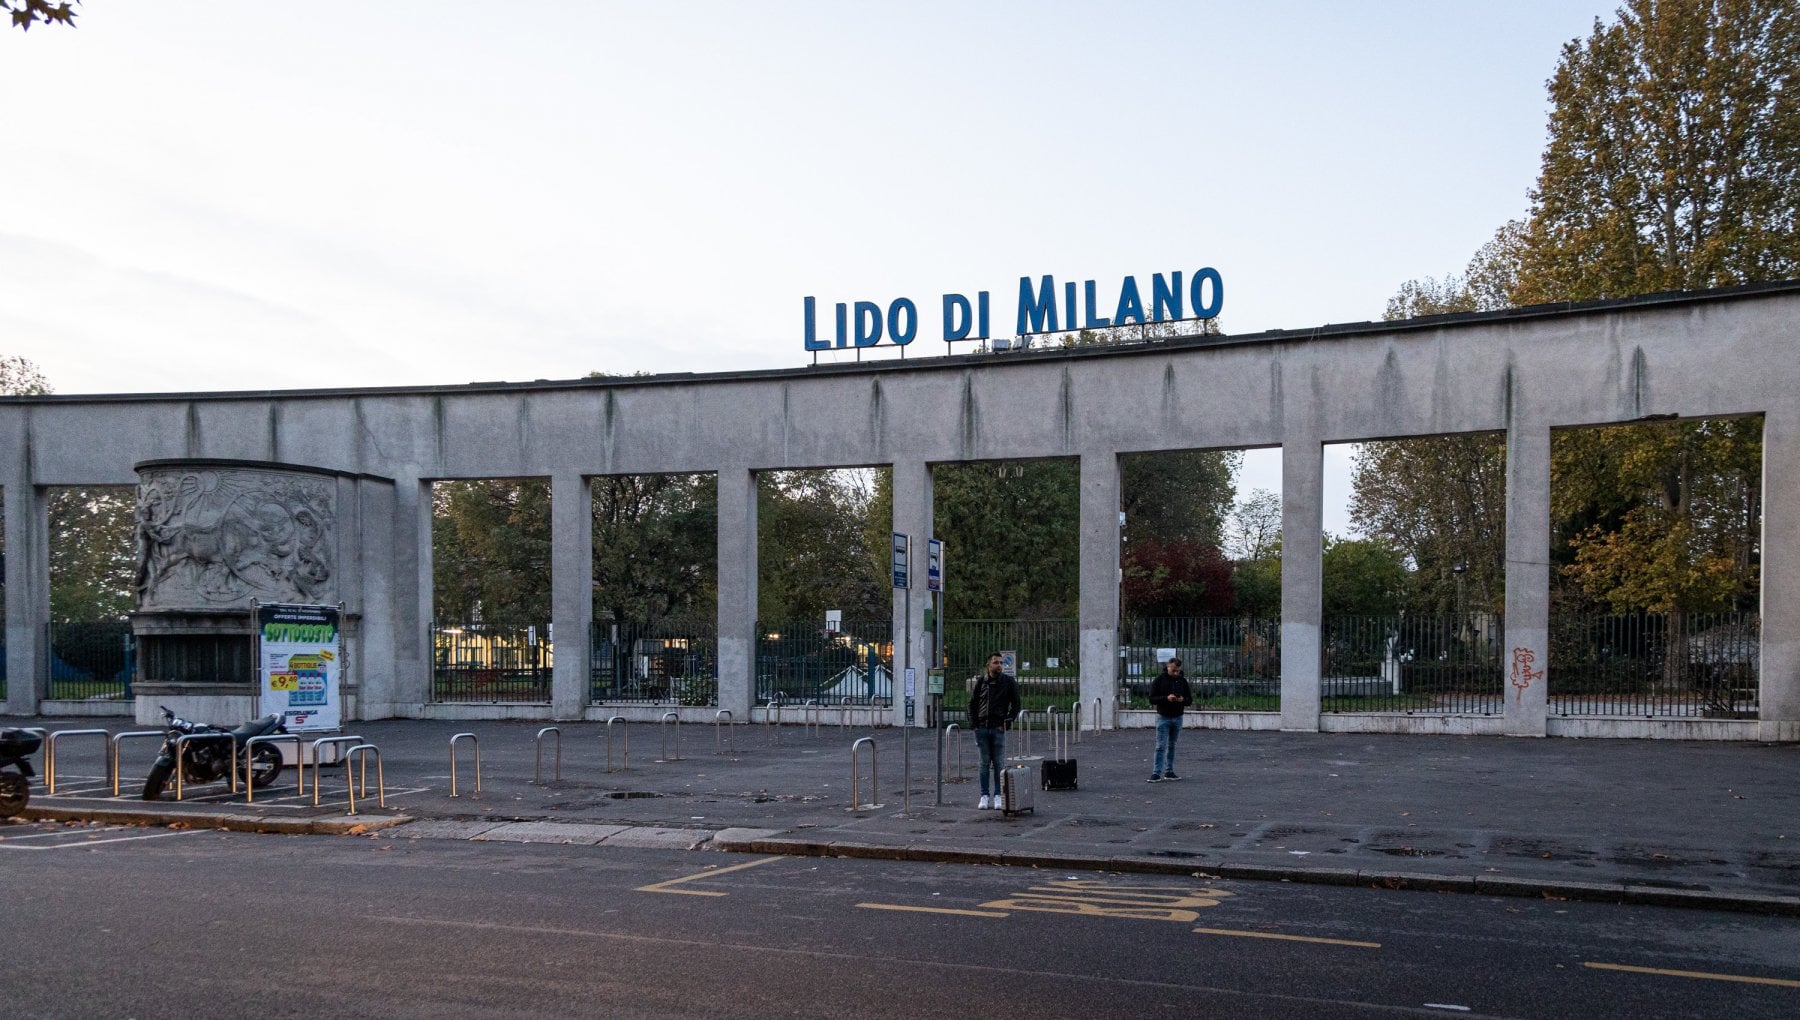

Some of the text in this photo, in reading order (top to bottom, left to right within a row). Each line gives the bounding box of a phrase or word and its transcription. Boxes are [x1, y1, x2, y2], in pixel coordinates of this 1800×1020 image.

[804, 267, 1224, 351] LIDO DI MILANO
[976, 880, 1237, 922] BUS
